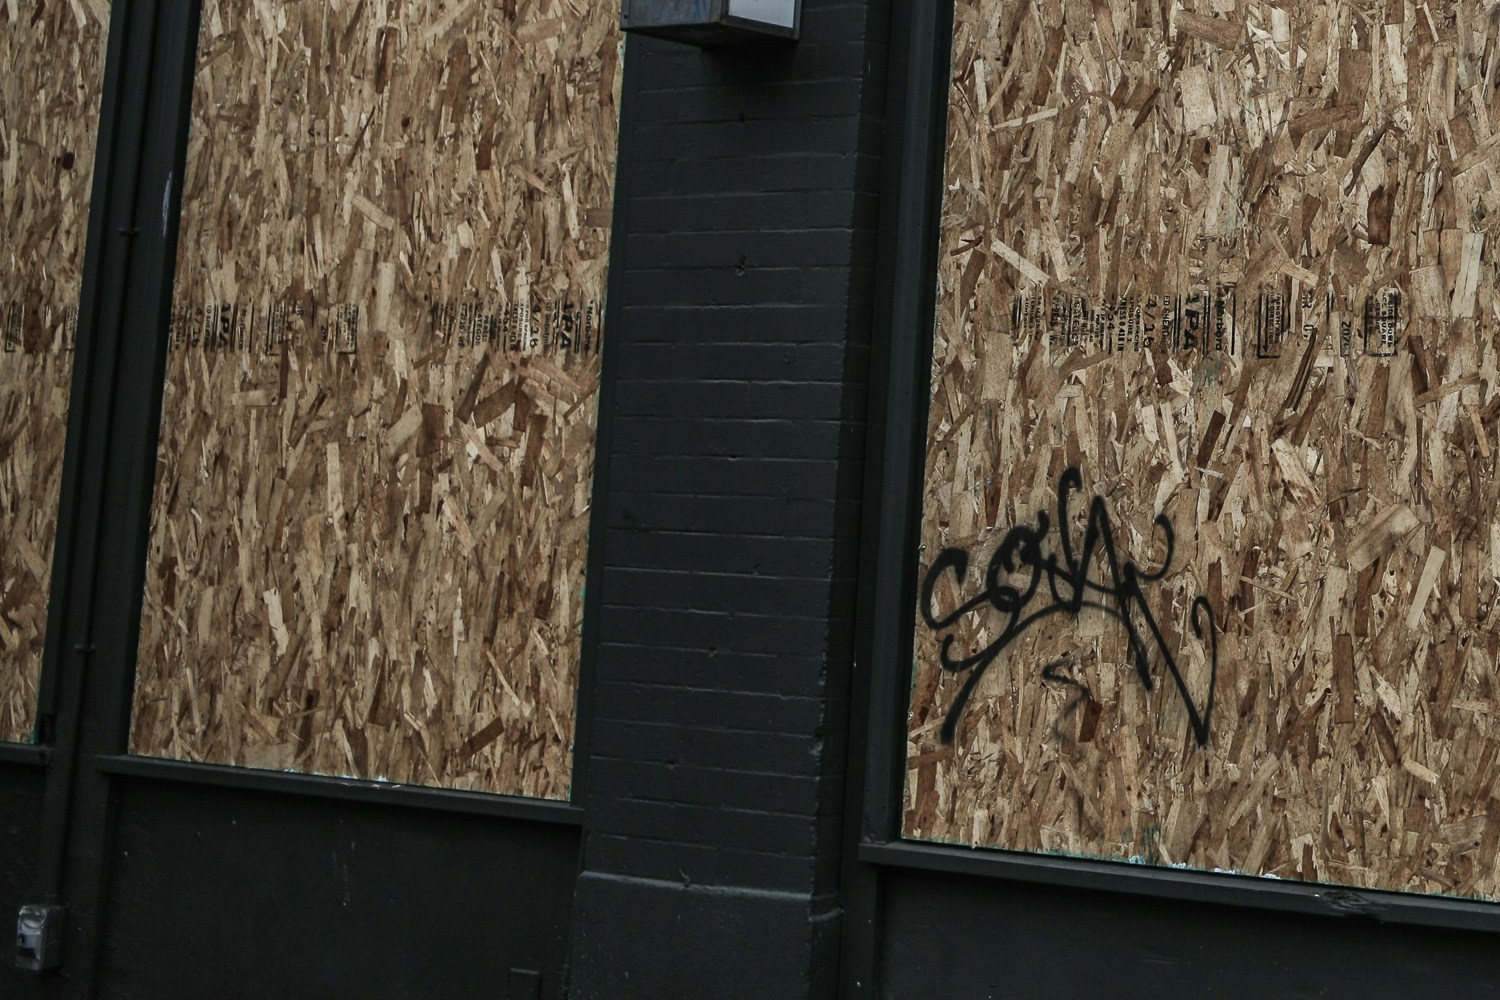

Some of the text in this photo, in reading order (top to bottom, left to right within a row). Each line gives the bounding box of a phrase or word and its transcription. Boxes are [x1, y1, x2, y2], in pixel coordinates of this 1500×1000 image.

[218, 303, 231, 348] APA
[560, 301, 574, 350] APA
[584, 307, 593, 351] Norbord
[1214, 300, 1225, 351] Norbord
